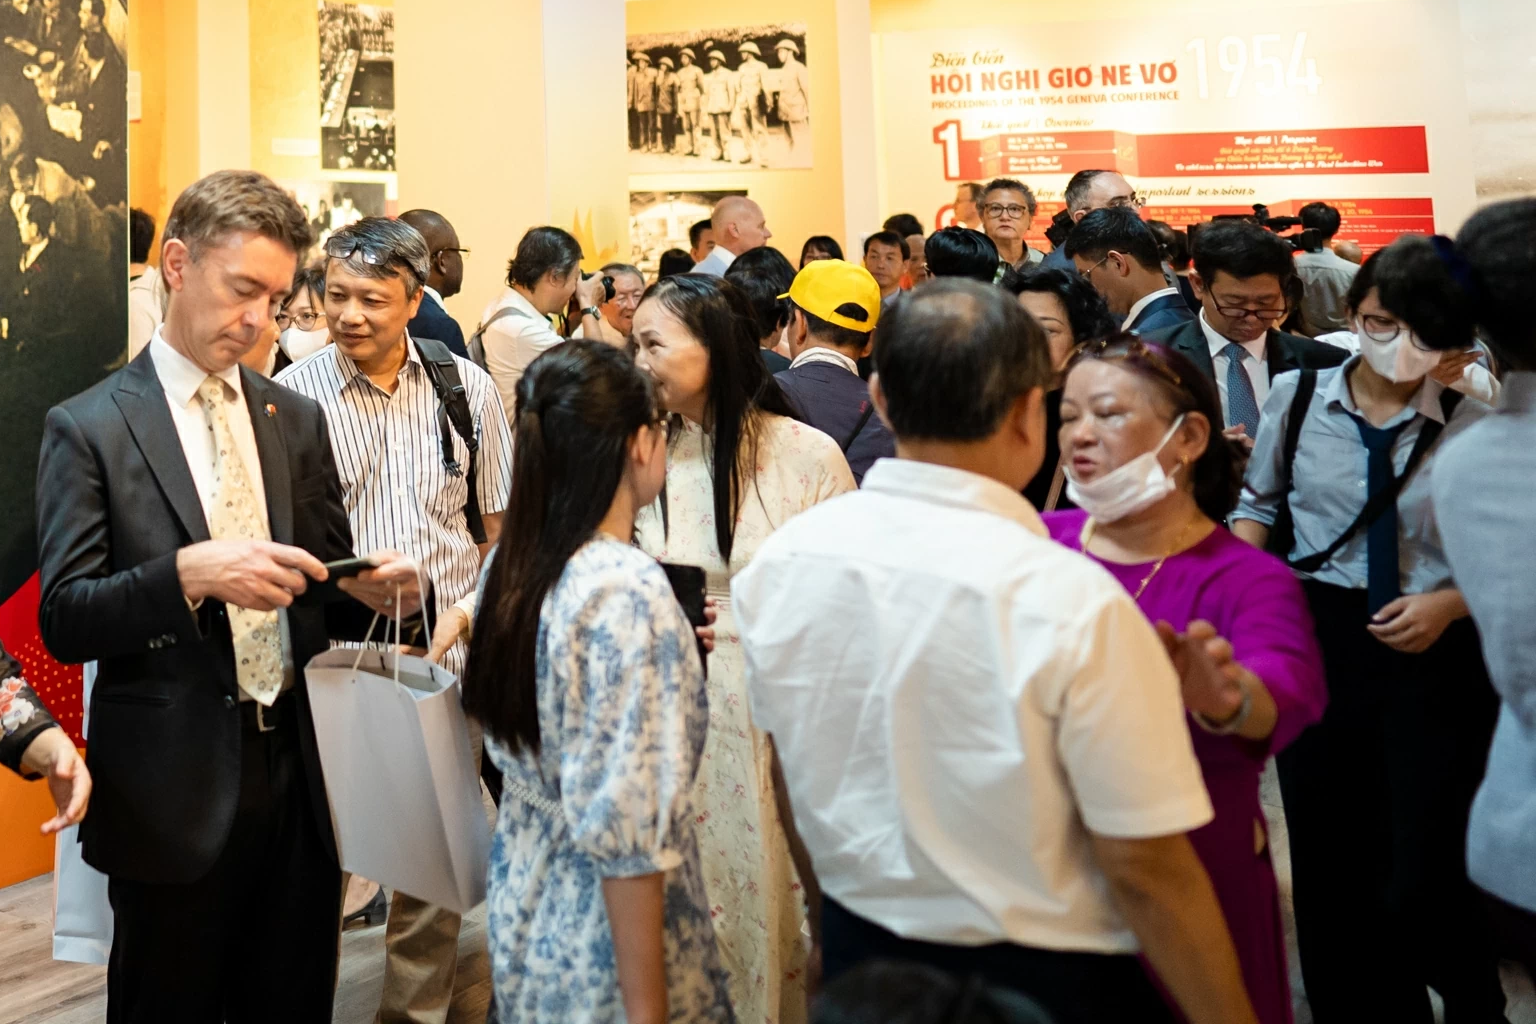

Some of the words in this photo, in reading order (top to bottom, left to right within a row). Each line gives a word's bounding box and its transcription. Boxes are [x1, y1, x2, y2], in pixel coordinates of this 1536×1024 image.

[1186, 31, 1322, 100] 1954
[930, 67, 972, 96] HỘI
[980, 68, 1041, 93] NGHỊ
[931, 98, 998, 111] PROCEEDINGS
[1018, 96, 1036, 106] THE
[1039, 95, 1064, 106] 1954
[1067, 93, 1108, 105] GENEVA
[1110, 90, 1180, 103] CONFERENCE
[933, 119, 964, 181] 1
[1196, 185, 1255, 197] sessions
